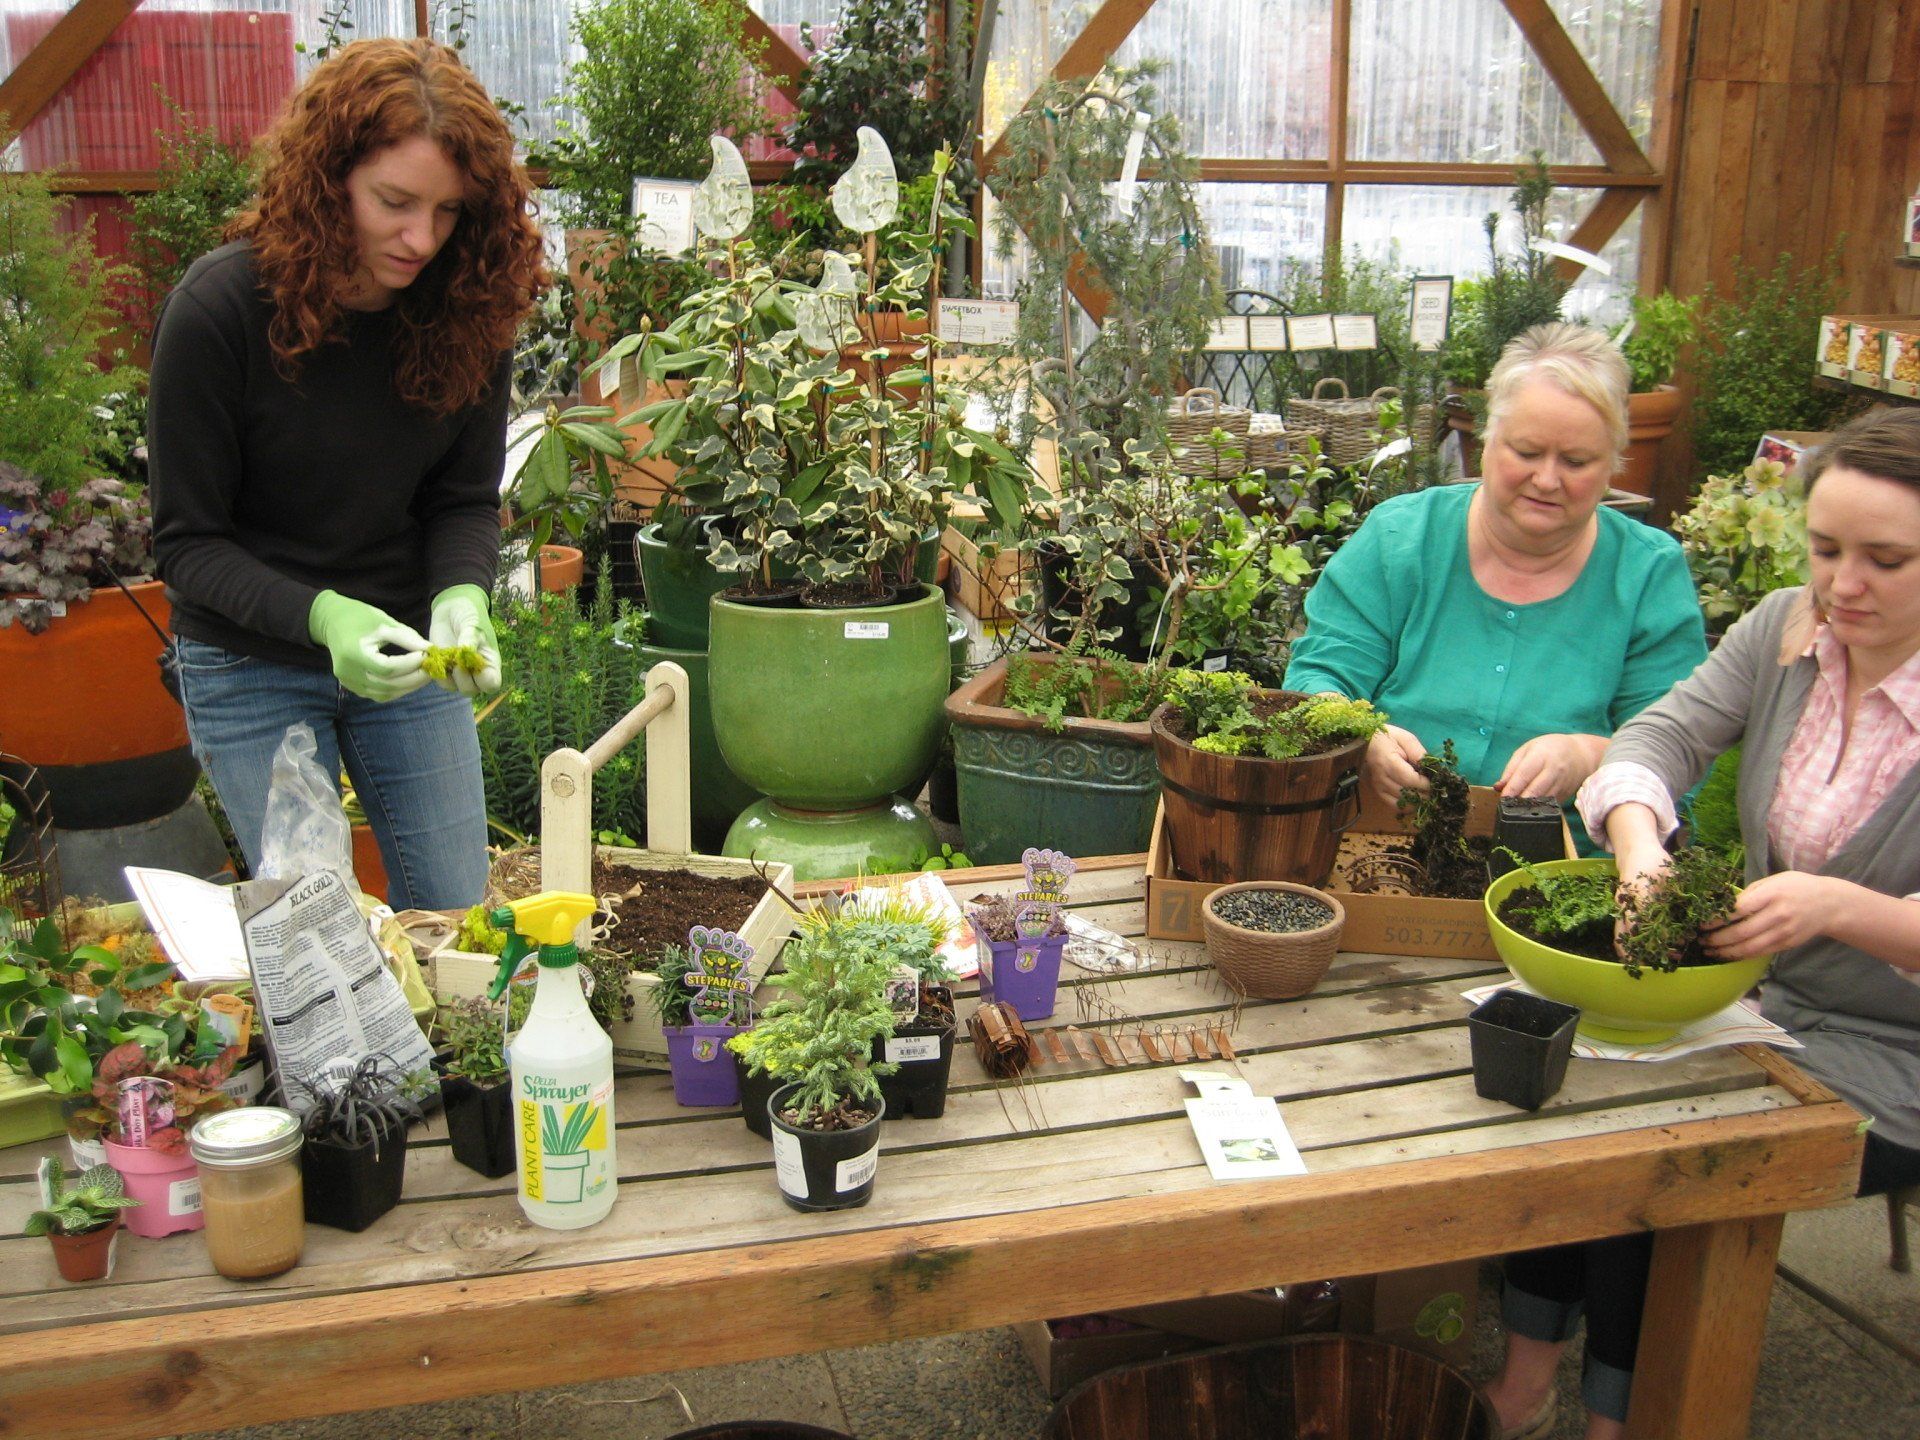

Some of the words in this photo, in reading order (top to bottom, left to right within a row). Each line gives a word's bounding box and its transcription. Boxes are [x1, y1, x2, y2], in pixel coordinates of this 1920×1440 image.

[654, 191, 679, 206] TEA
[941, 304, 983, 314] SWEETBOX
[289, 885, 314, 908] BLACK
[313, 874, 333, 893] GOLD
[1383, 926, 1492, 949] 503.777.7
[687, 974, 747, 991] STEPABLES
[523, 1074, 591, 1103] Sprayer
[533, 1075, 557, 1086] DELTA
[522, 1100, 536, 1144] CARE
[525, 1147, 540, 1199] PLANT
